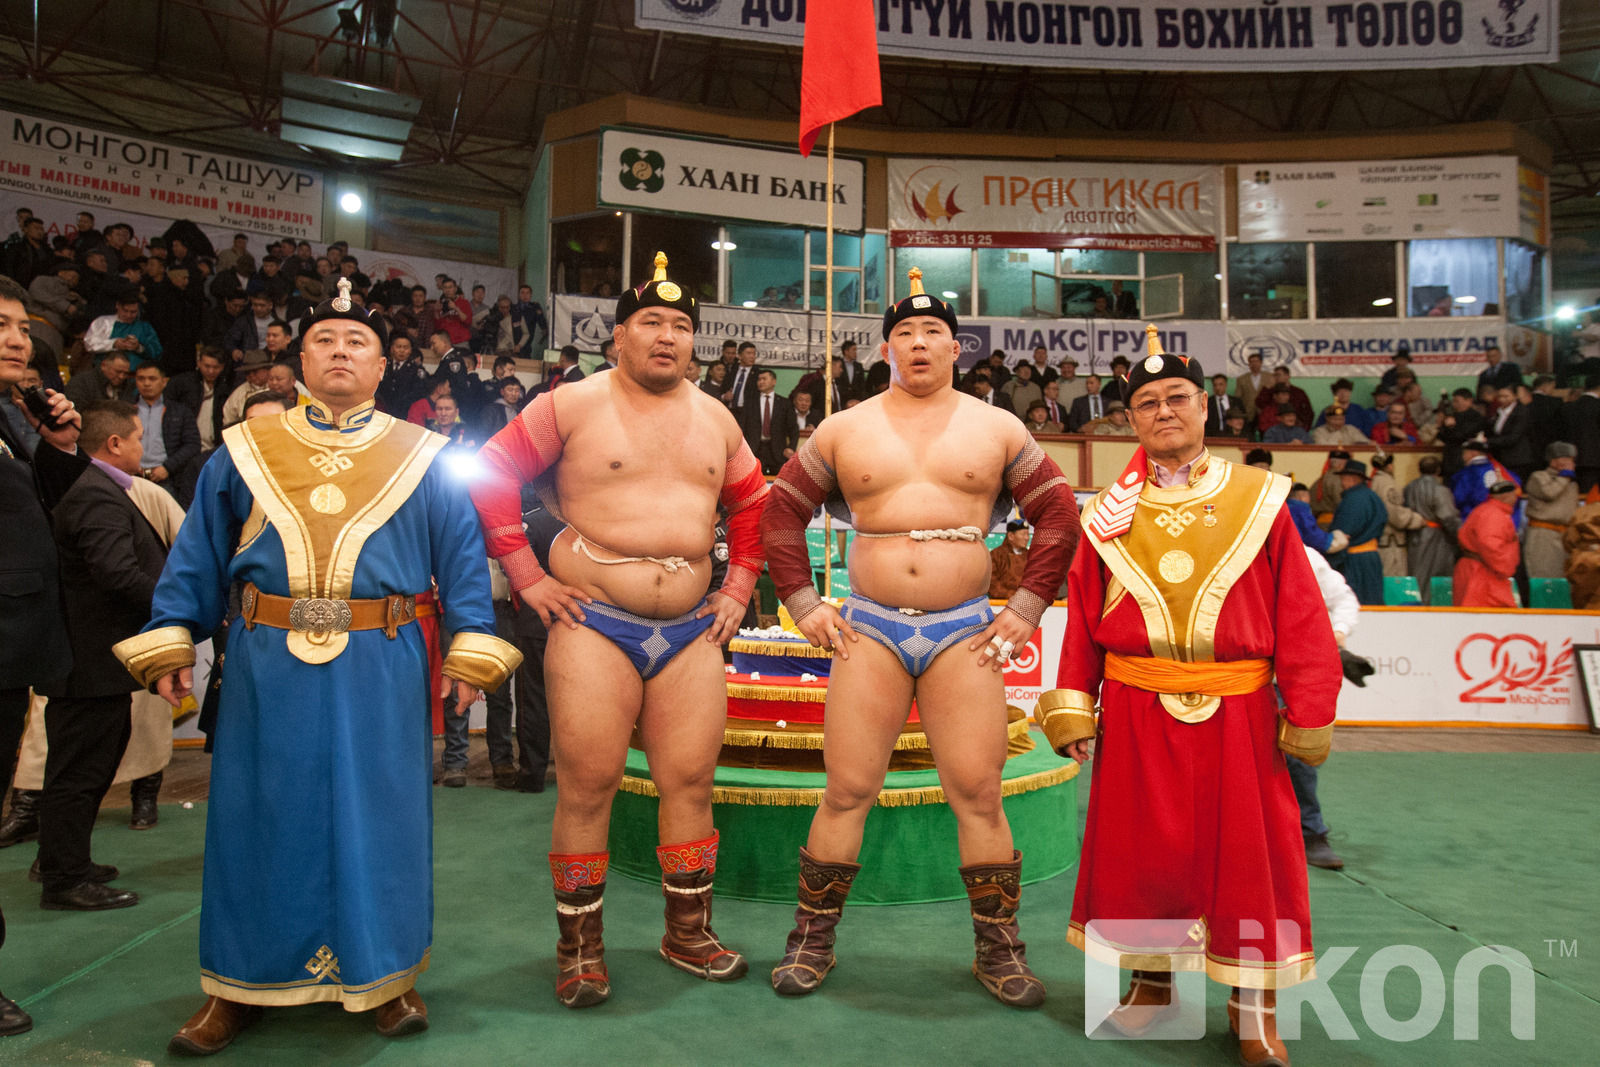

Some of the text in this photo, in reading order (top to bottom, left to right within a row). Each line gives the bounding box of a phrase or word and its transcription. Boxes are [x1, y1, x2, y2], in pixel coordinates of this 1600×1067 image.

[986, 0, 1142, 47] МОНГОЛ
[1157, 0, 1314, 49] БӨХИЙН
[1327, 1, 1464, 47] ТӨЛӨӨ
[12, 117, 315, 194] МОНГОЛ ТАШУУР
[40, 167, 141, 197] МАТЕРИАЛЫН
[58, 156, 277, 202] КОНСТРАКШН
[678, 164, 848, 205] ХААН БАНК
[983, 175, 1200, 213] ПРАКТИКАЛ
[942, 234, 957, 245] 33
[961, 234, 974, 245] 15
[978, 234, 993, 245] 25
[698, 319, 801, 343] ПРОГРЕСС
[1003, 328, 1087, 352] МАКС
[1098, 330, 1187, 353] ГРУПП
